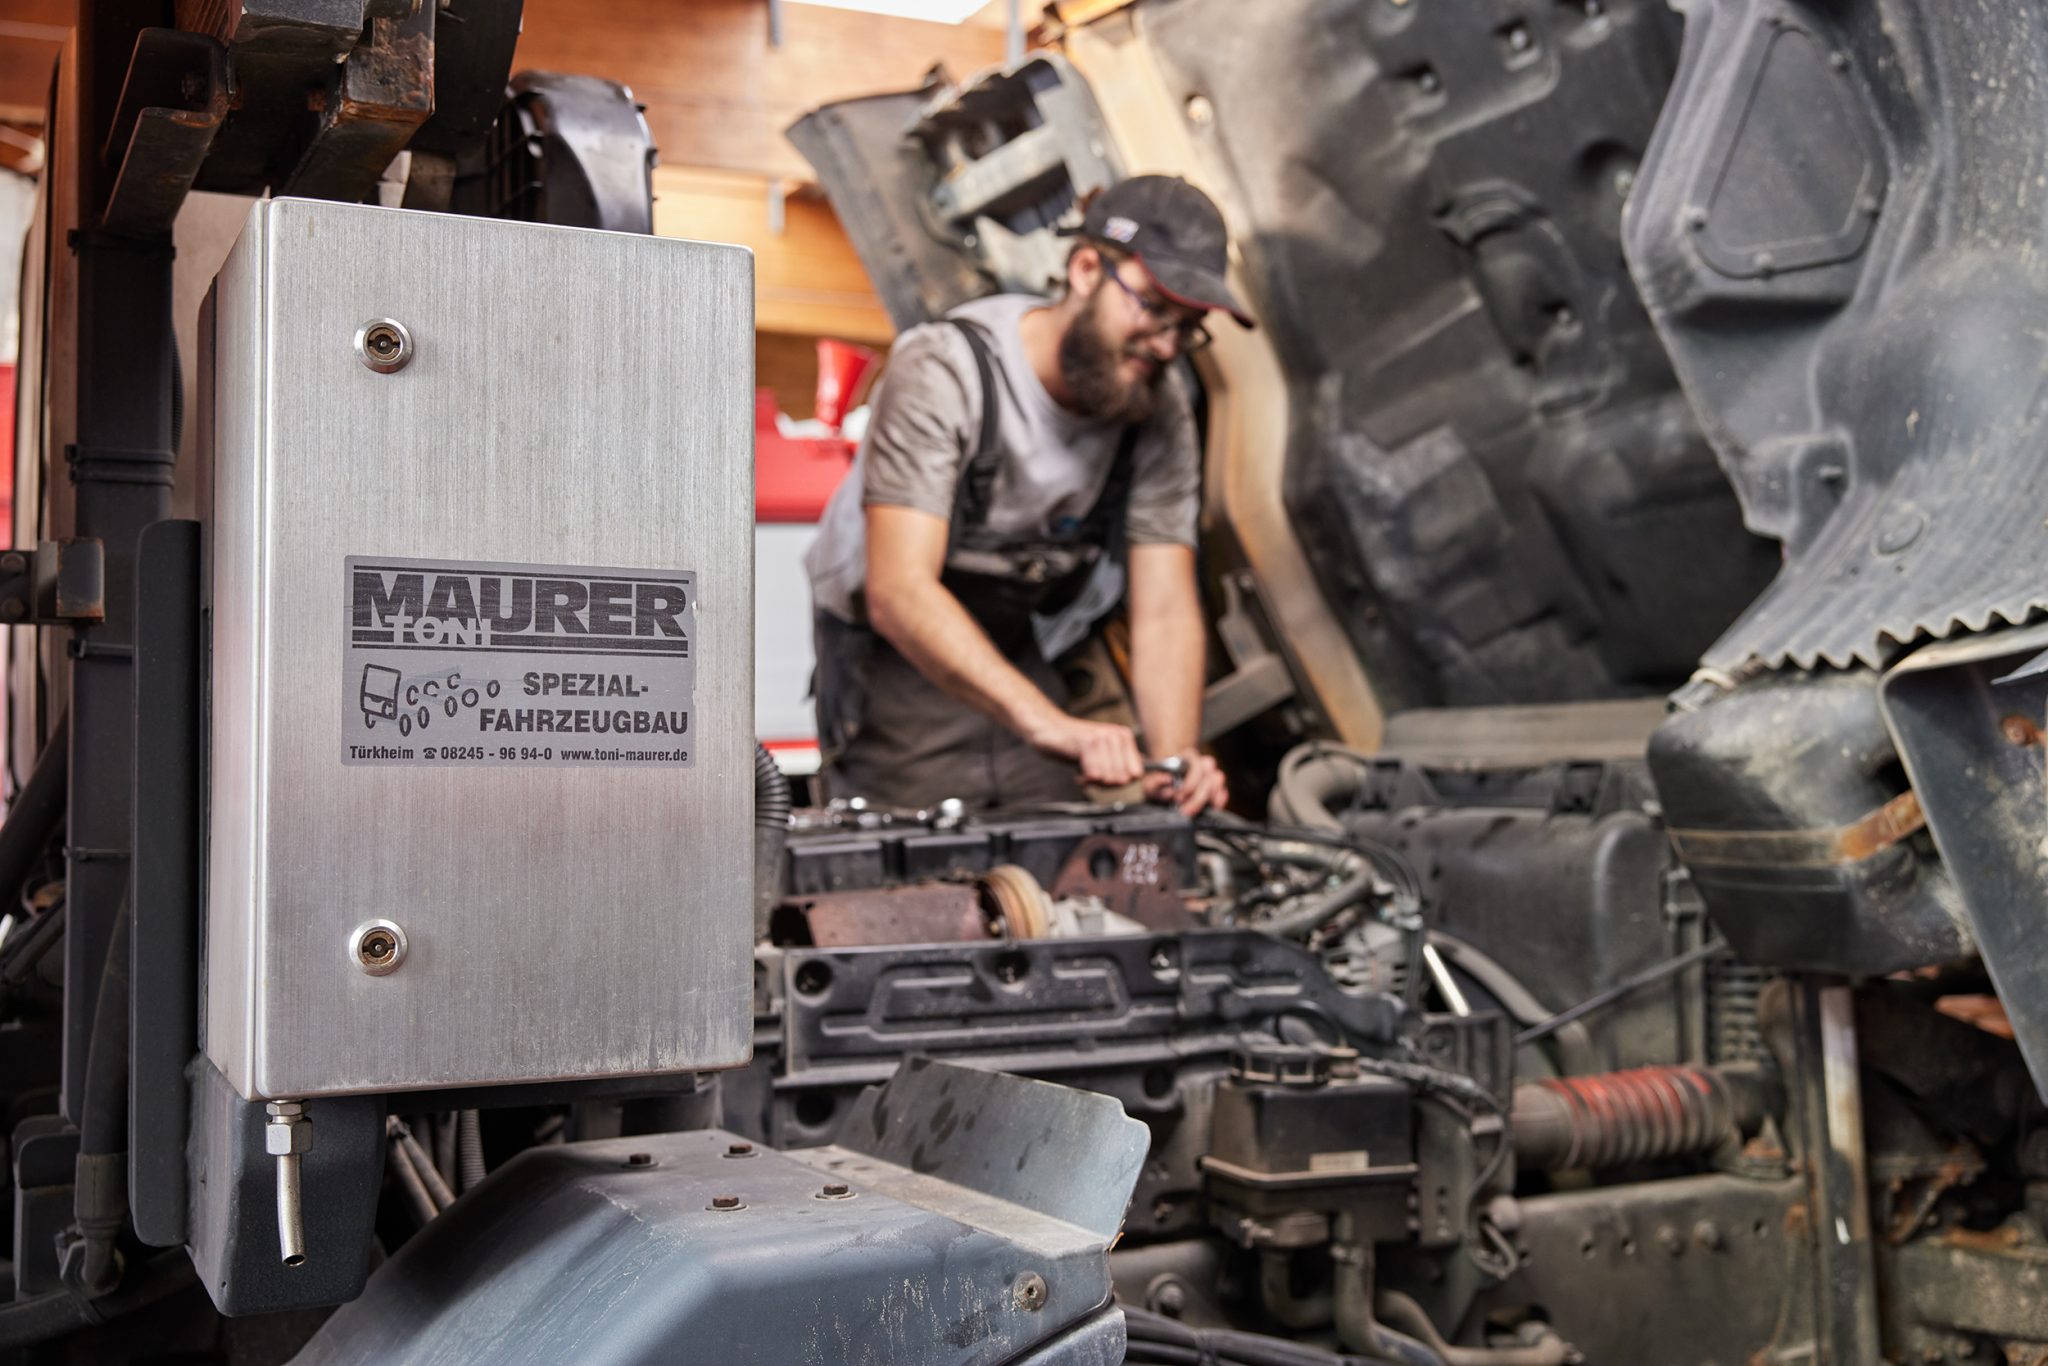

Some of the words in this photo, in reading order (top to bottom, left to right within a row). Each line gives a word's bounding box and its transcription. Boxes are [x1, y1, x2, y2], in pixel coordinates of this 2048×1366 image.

[353, 572, 687, 638] MAURER
[523, 672, 649, 698] SPEZIAL-
[480, 708, 688, 734] FAHRZEUGBAU
[350, 745, 414, 760] Türkheim
[440, 746, 484, 760] 08245
[499, 747, 516, 760] 96
[521, 747, 553, 760] 94-0
[561, 748, 688, 762] www.toni-maurer.de
